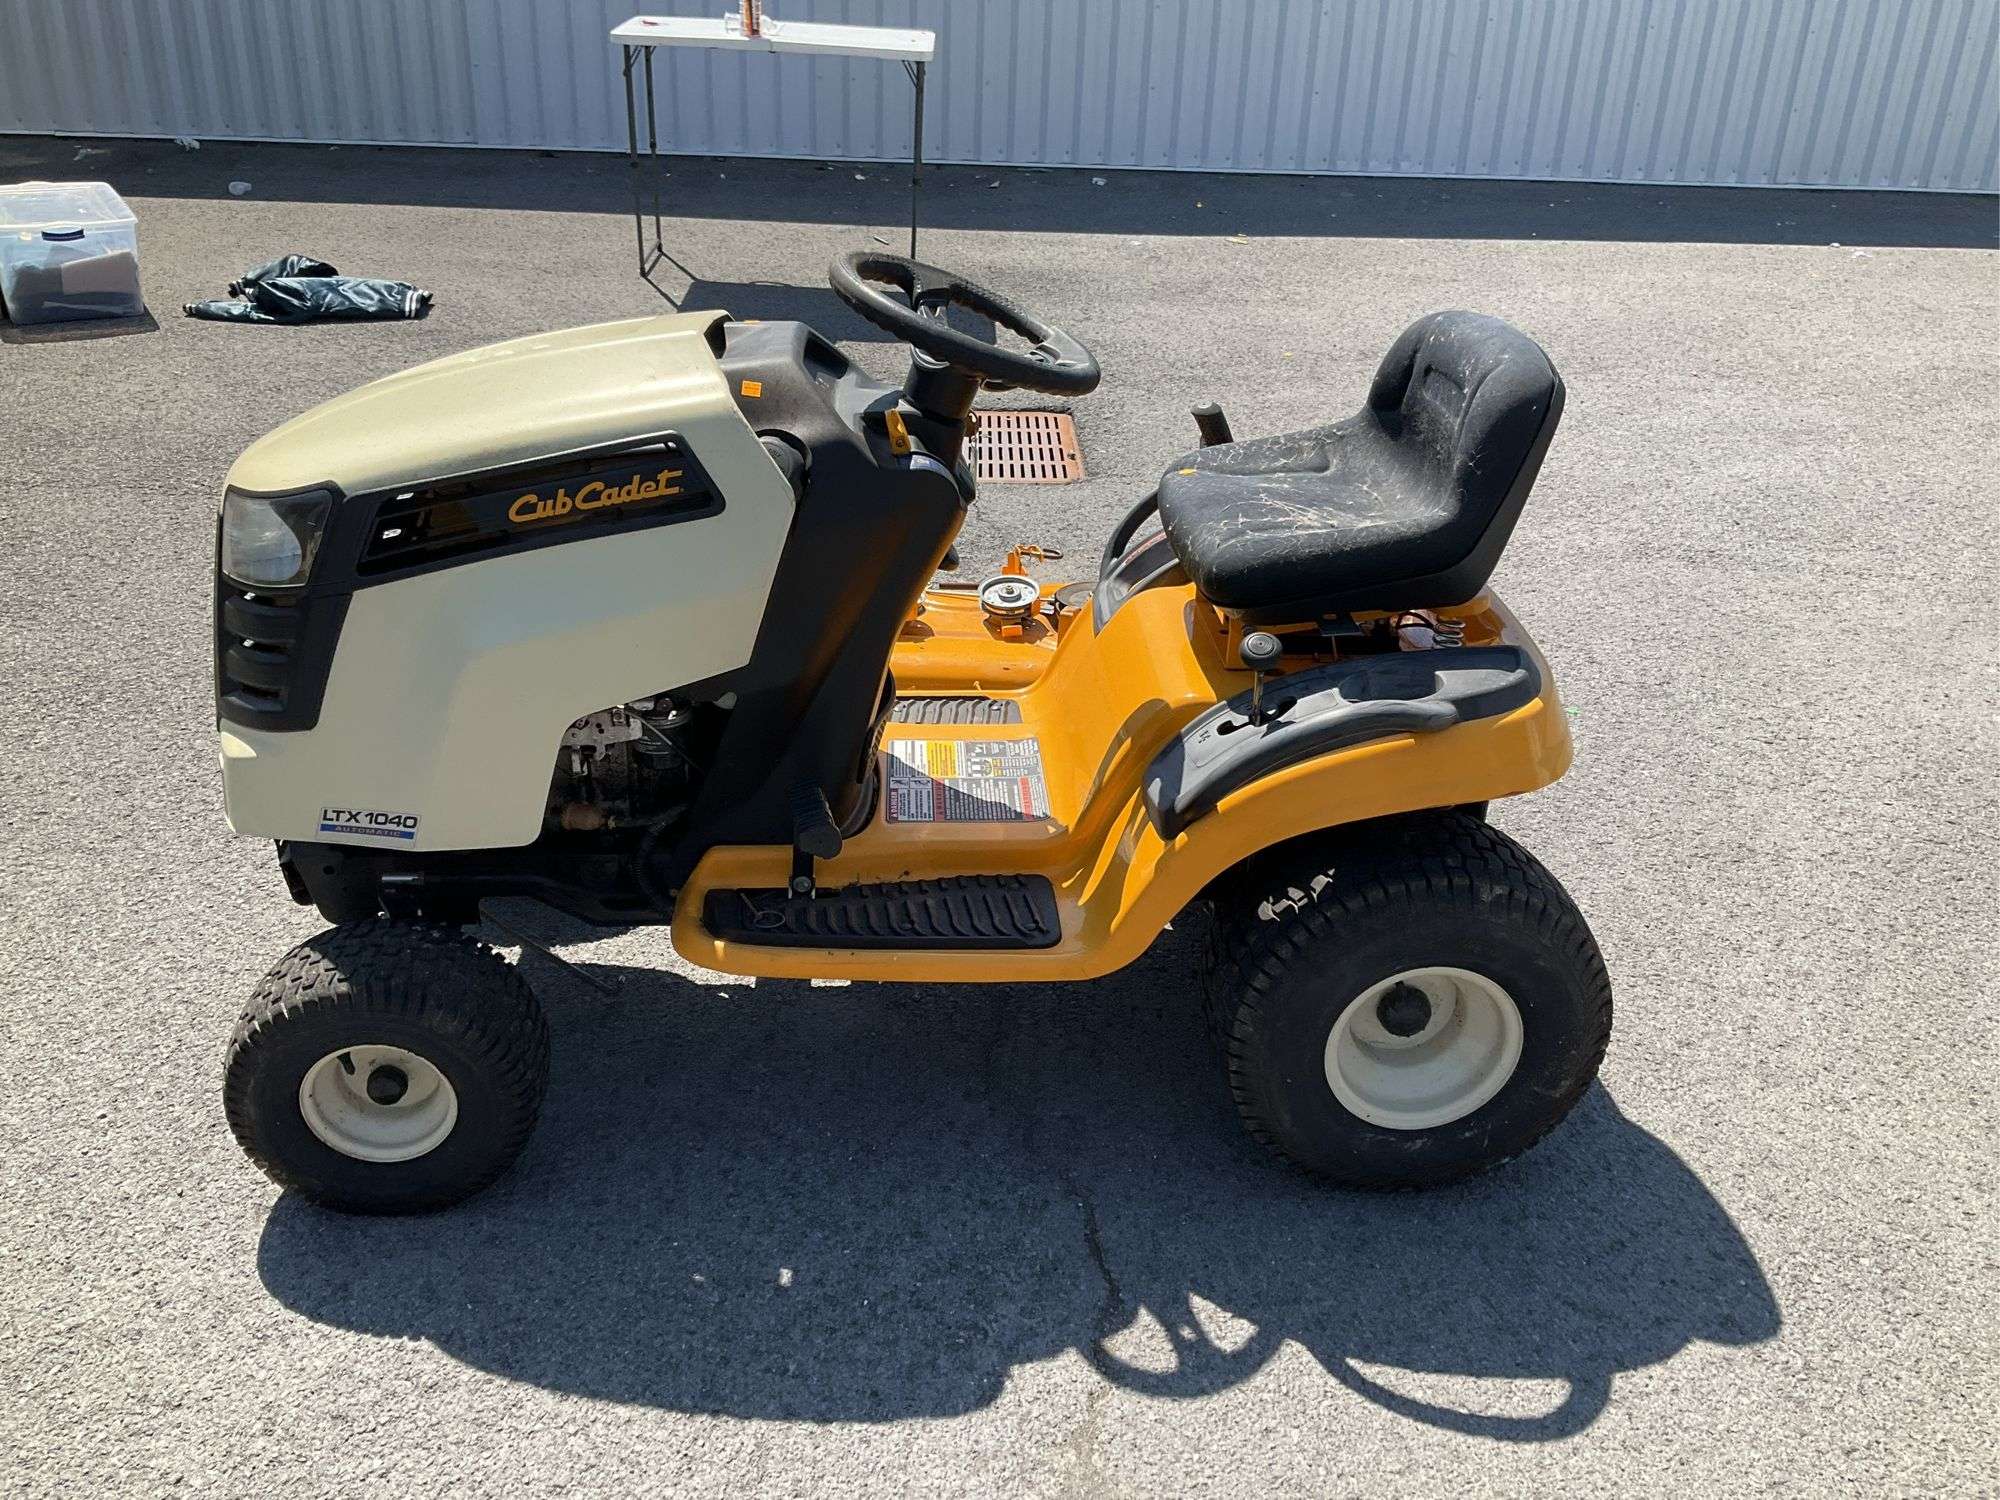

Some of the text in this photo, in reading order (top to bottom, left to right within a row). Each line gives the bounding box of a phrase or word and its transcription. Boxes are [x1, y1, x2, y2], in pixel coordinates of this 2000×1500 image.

[508, 469, 684, 523] Cub Cadet
[322, 809, 418, 829] LTX 1040
[335, 825, 401, 837] AUTOMATIC
